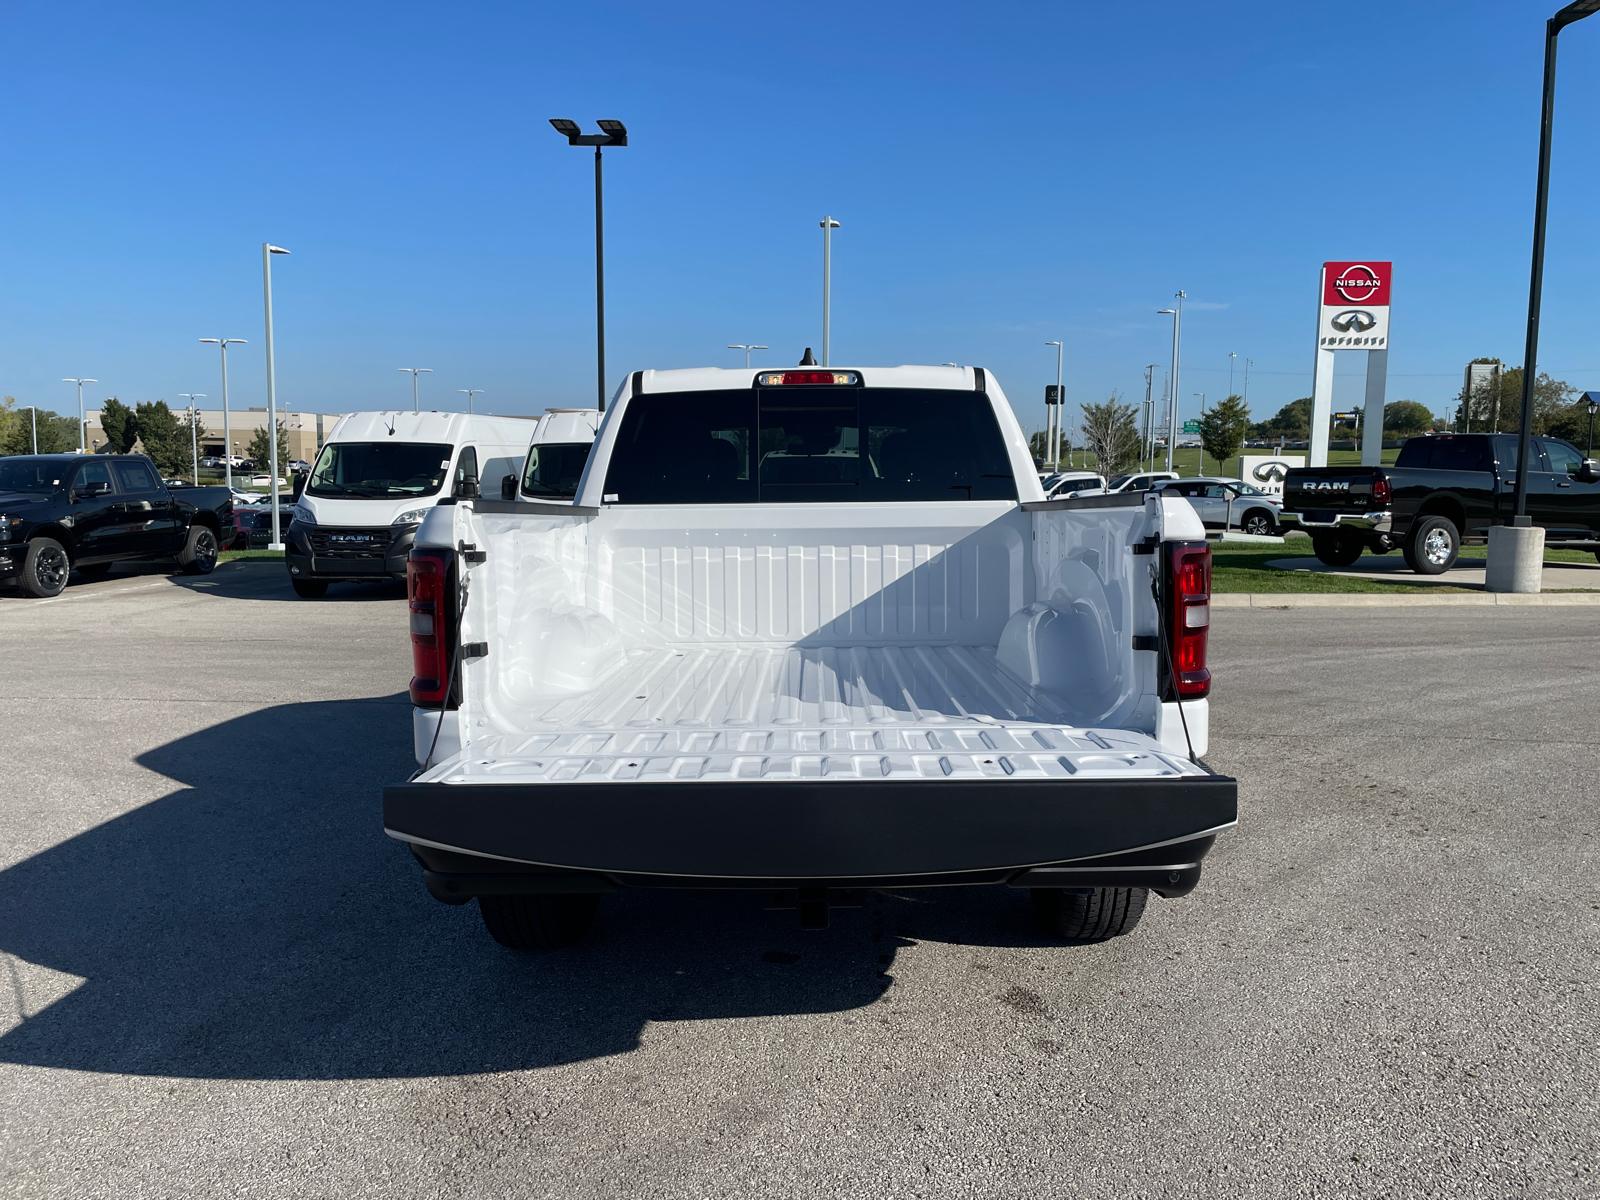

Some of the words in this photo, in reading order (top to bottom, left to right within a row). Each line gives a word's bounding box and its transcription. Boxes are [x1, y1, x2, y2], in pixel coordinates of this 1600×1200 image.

[1336, 279, 1380, 287] NISSAN
[1320, 336, 1385, 346] INFINITI
[1302, 482, 1350, 490] RAM
